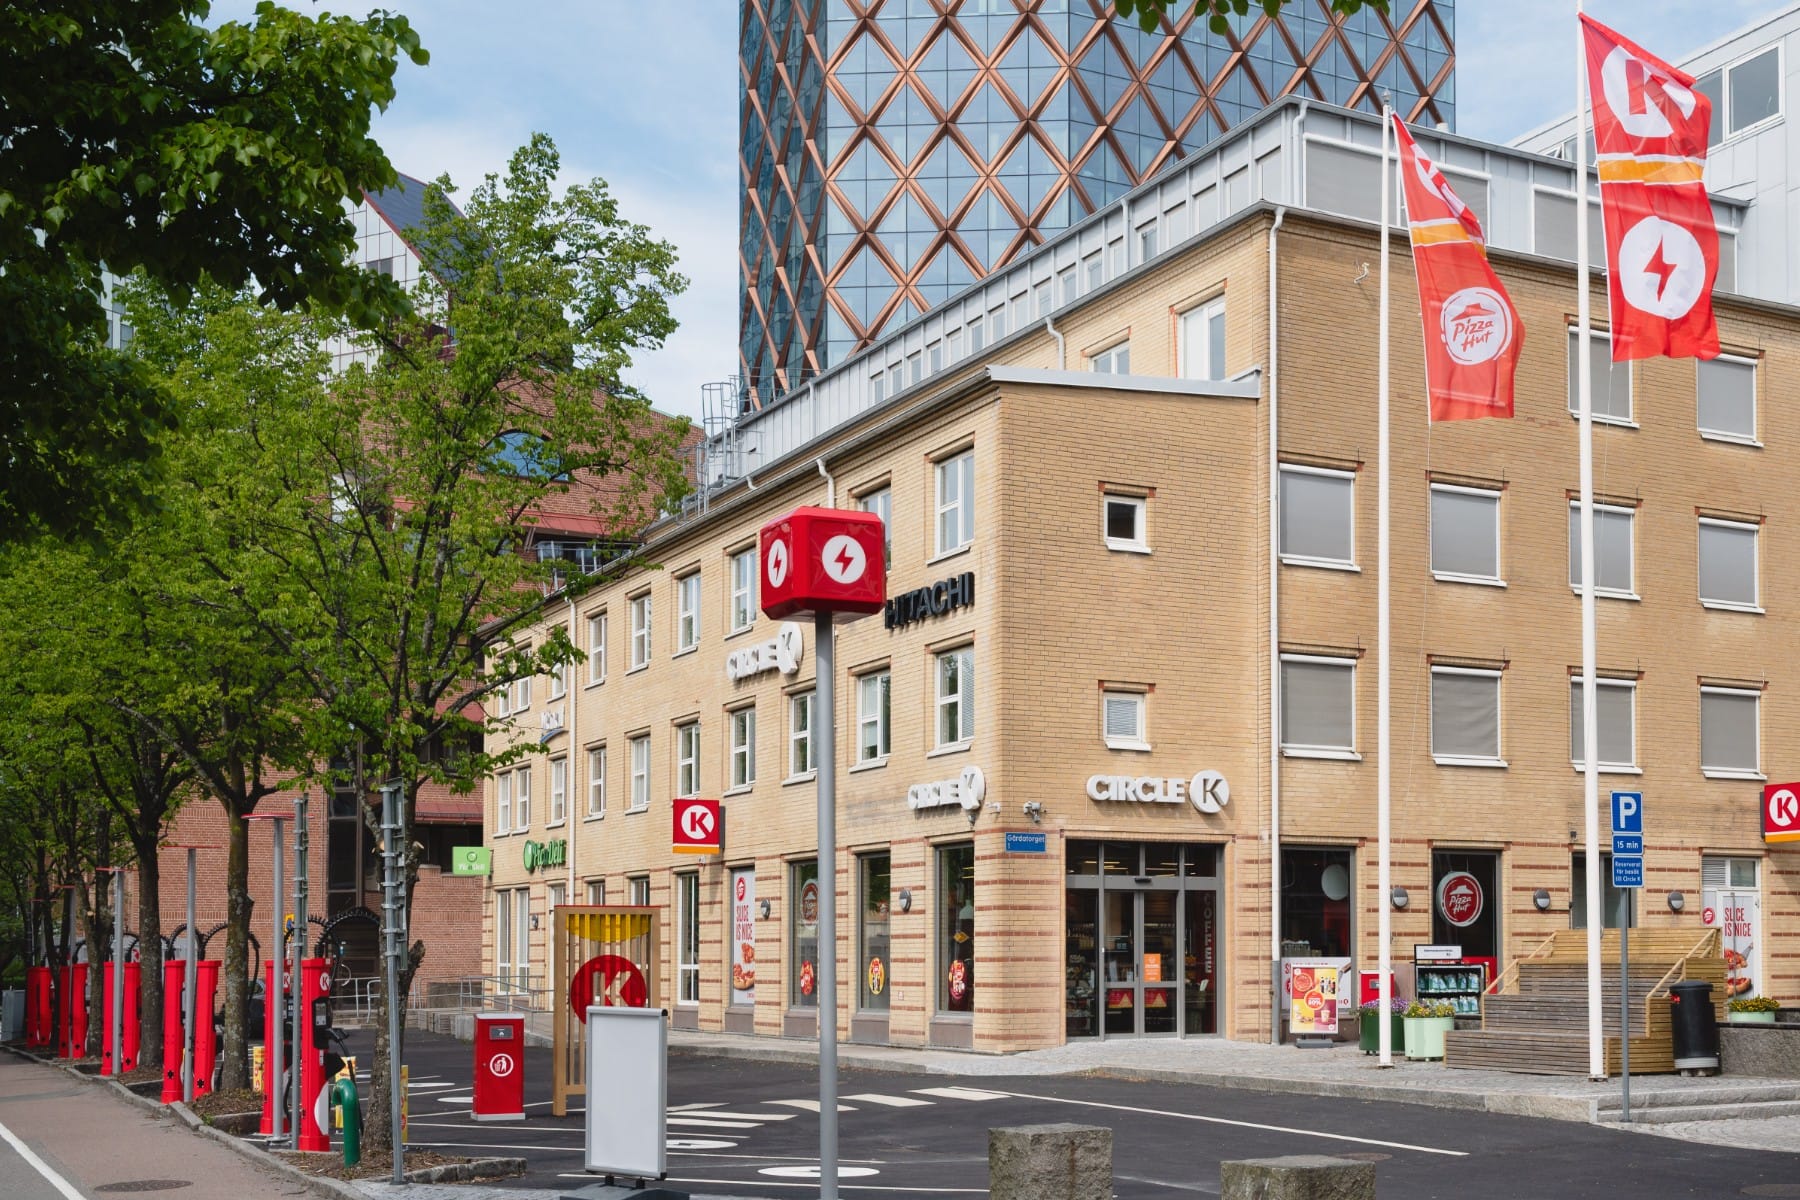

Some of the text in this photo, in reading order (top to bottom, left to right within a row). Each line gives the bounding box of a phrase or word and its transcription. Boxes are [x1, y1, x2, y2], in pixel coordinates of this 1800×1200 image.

[1453, 318, 1494, 342] Pizza
[1461, 330, 1493, 352] Hut
[884, 571, 975, 630] HITACHI
[1086, 773, 1229, 811] CIRCLE K
[1619, 795, 1637, 829] P
[1773, 793, 1797, 824] K
[686, 809, 714, 838] K
[1007, 834, 1046, 844] Gårdatorget
[1617, 841, 1639, 849] 15 min
[1449, 894, 1472, 907] Pizza
[1452, 903, 1470, 914] Hut
[1725, 907, 1745, 922] SLCE
[742, 922, 753, 941] NICE
[1724, 922, 1752, 937] IS NICE
